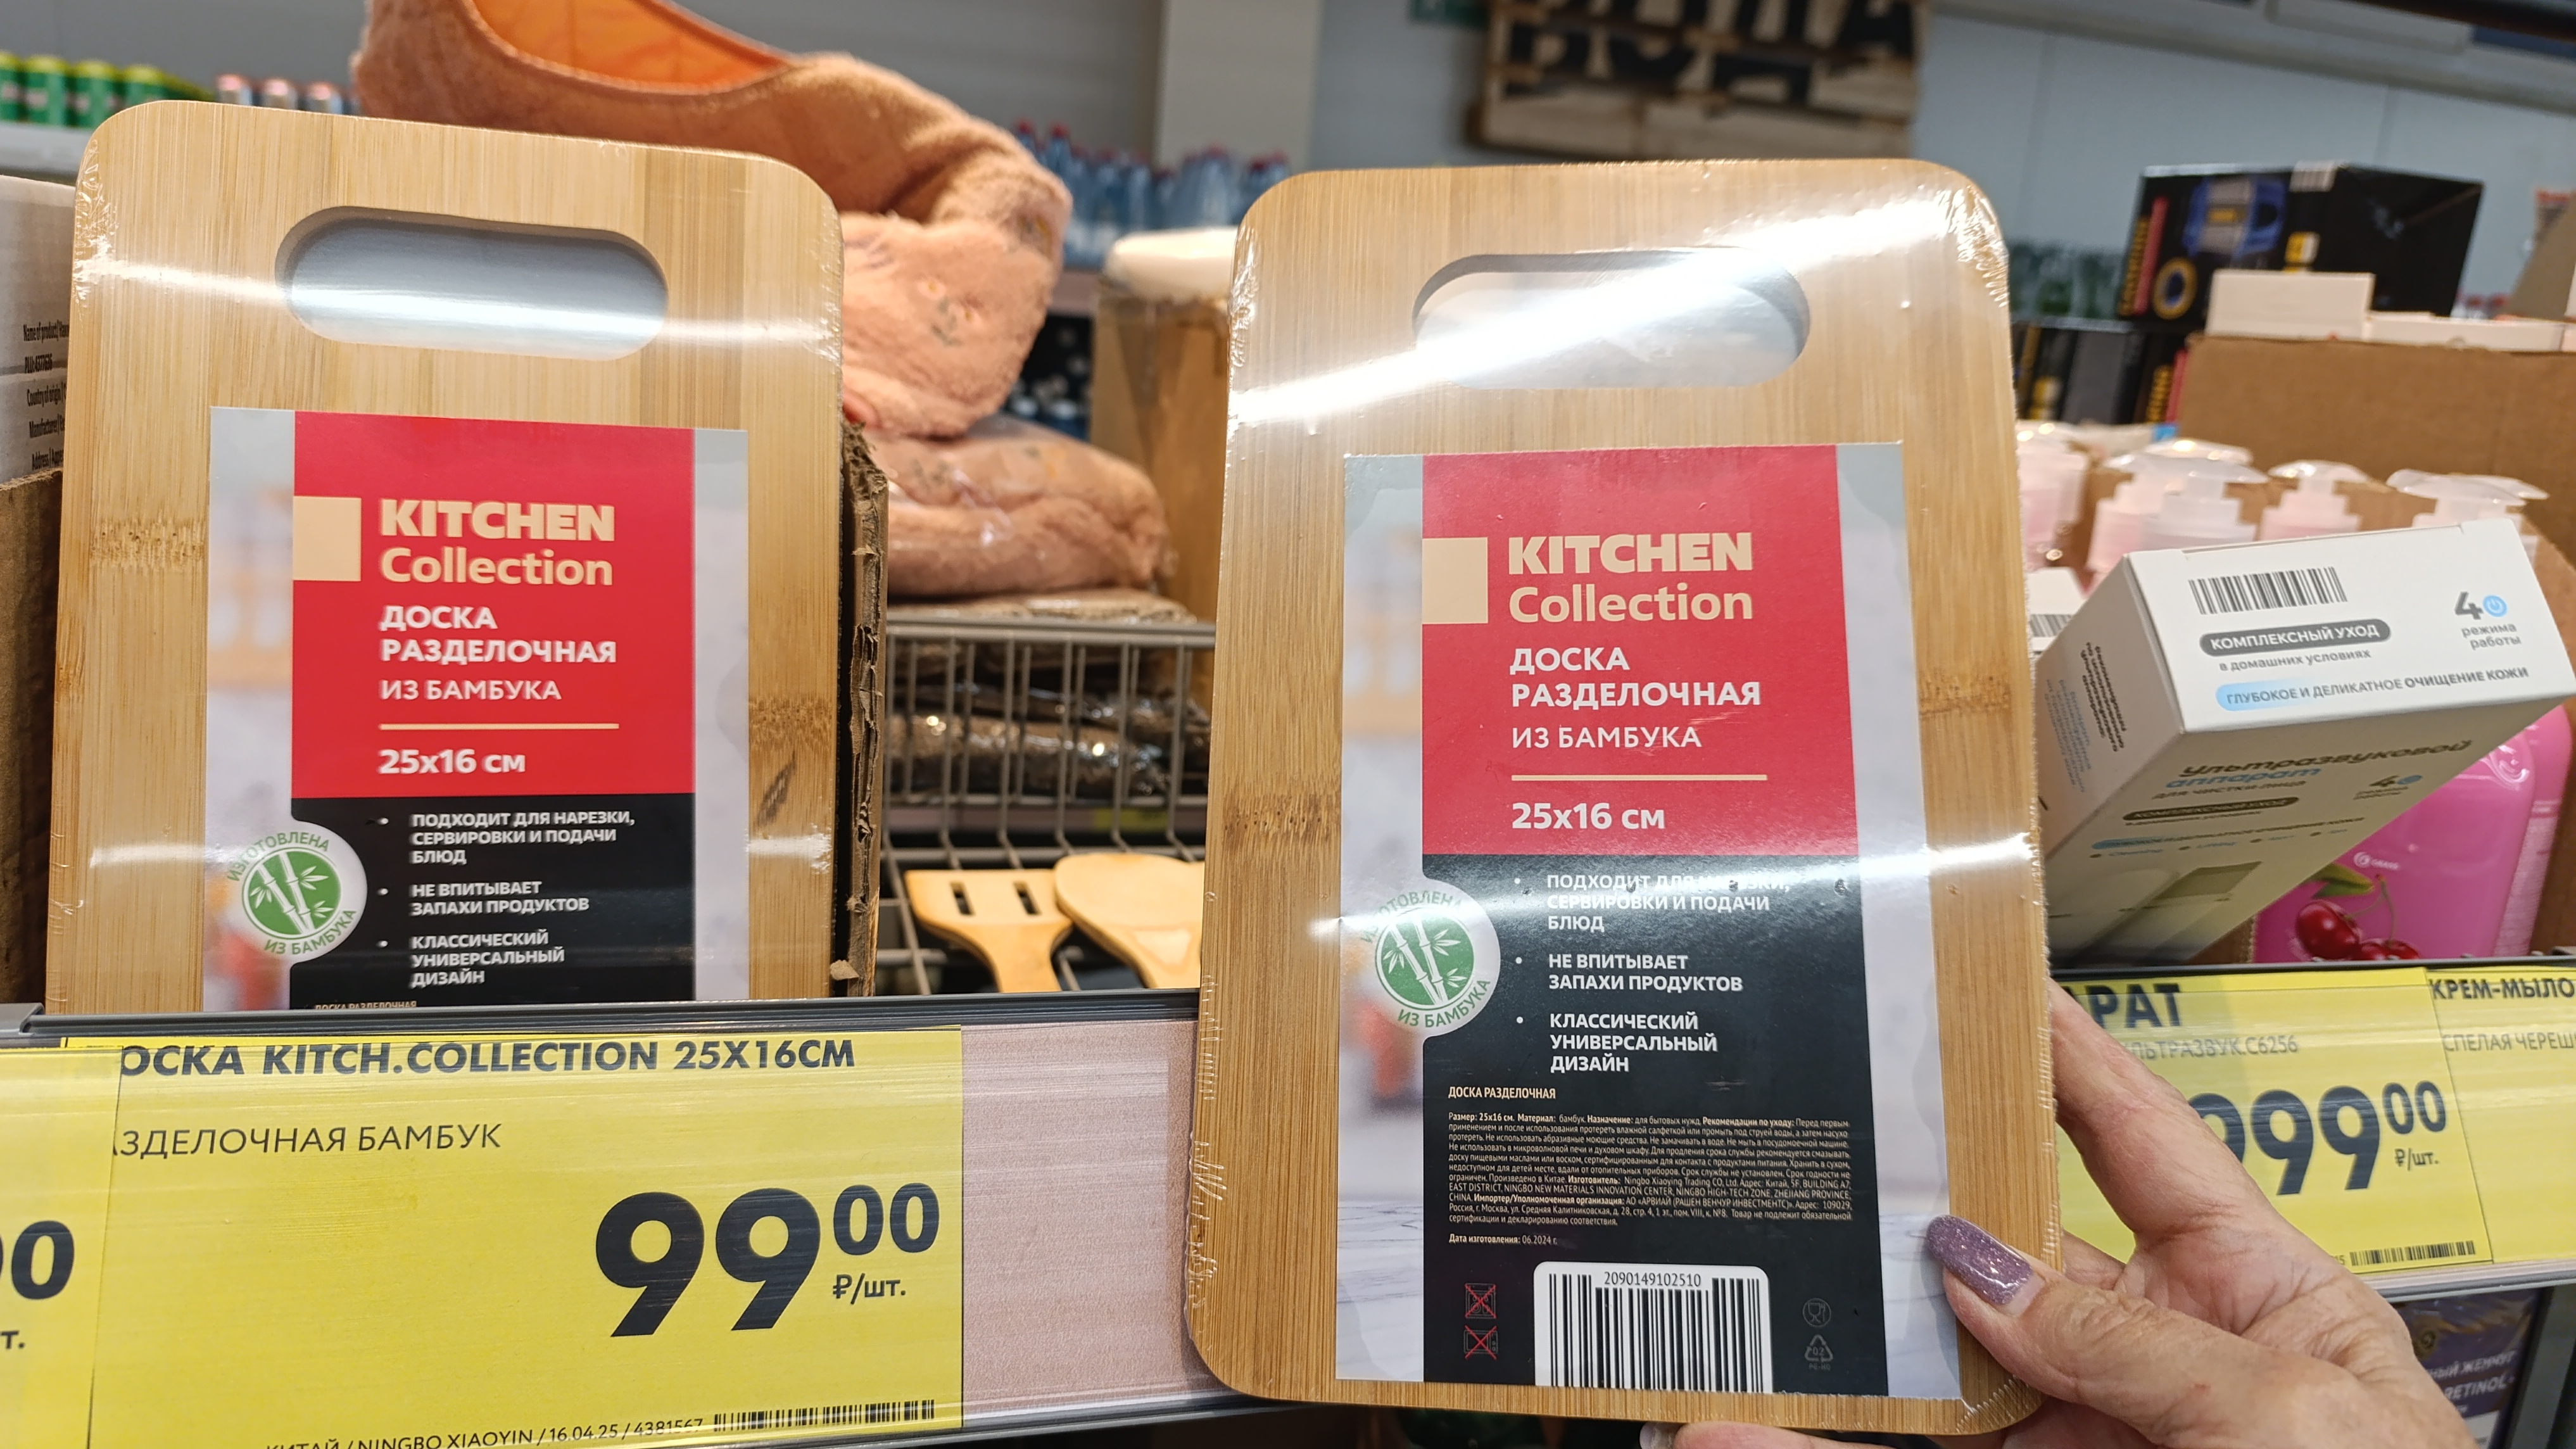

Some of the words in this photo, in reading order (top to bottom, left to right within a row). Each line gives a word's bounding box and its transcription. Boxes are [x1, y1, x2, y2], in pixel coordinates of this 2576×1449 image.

[380, 498, 616, 541] KITCHEN
[1508, 532, 1753, 574] KITCHEN
[380, 546, 614, 585] Collection
[1509, 581, 1753, 623] Collection
[2454, 591, 2484, 620] 4
[379, 605, 498, 631] ДОСКА
[2209, 626, 2335, 650] КОМПЛЕКСНЫЙ
[2334, 624, 2381, 640] УХОД
[2461, 623, 2517, 638] режима
[380, 638, 616, 665] РАЗДЕЛОЧНАЯ
[2470, 635, 2522, 650] работы
[1509, 647, 1630, 675] ДОСКА
[2219, 662, 2228, 671] в
[2230, 655, 2304, 673] домашних
[2305, 649, 2372, 666] условиях
[380, 679, 419, 700] ИЗ
[426, 680, 562, 700] БАМБУКА
[1511, 681, 1761, 710] РАЗДЕЛОЧНАЯ
[2226, 688, 2298, 705] ГЛУБОКОЕ
[2299, 687, 2311, 698] И
[2312, 678, 2403, 699] ДЕЛИКАТНОЕ
[2404, 670, 2485, 688] ОЧИЩЕНИЕ
[2485, 666, 2529, 681] КОЖИ
[1512, 727, 1550, 748] ИЗ
[1558, 726, 1702, 749] БАМБУКА
[378, 749, 477, 775] 25х16
[483, 754, 526, 773] см
[410, 813, 511, 830] ПОДХОДИТ
[514, 811, 551, 828] ДЛЯ
[553, 810, 635, 826] НАРЕЗКИ,
[1511, 802, 1612, 829] 25х16
[1621, 809, 1665, 829] см
[410, 830, 526, 845] СЕРВИРОВКИ
[529, 830, 543, 843] И
[545, 828, 617, 844] ПОДАЧИ
[227, 832, 330, 882] ИЗГОТОВЛЕНА
[410, 849, 467, 865] БЛЮД
[411, 883, 436, 898] НЕ
[439, 881, 542, 897] ВПИТЫВАЕТ
[1547, 875, 1651, 891] ПОДХОДИТ
[410, 900, 483, 916] ЗАПАХИ
[486, 897, 590, 915] ПРОДУКТОВ
[1547, 895, 1669, 910] СЕРВИРОВКИ
[1672, 895, 1687, 910] И
[1690, 896, 1770, 913] ПОДАЧИ
[264, 939, 286, 955] ИЗ
[291, 909, 357, 955] БАМБУКА
[1548, 916, 1605, 933] БЛЮД
[411, 929, 549, 950] КЛАССИЧЕСКИЙ
[410, 947, 565, 968] УНИВЕРСАЛЬНЫЙ
[1548, 953, 1573, 968] НЕ
[1576, 954, 1689, 970] ВПИТЫВАЕТ
[410, 968, 486, 989] ДИЗАЙН
[1549, 975, 1625, 990] ЗАПАХИ
[1628, 975, 1743, 994] ПРОДУКТОВ
[2428, 978, 2575, 999] КРЕМ-МЫЛО
[1397, 1008, 1420, 1027] ИЗ
[1424, 979, 1491, 1028] БАМБУКА
[1550, 1011, 1699, 1030] КЛАССИЧЕСКИЙ
[1550, 1032, 1719, 1053] УНИВЕРСАЛЬНЫЙ
[2441, 1033, 2512, 1051] СПЕЛАЯ
[2515, 1032, 2576, 1050] ЧЕРЕШ
[121, 1044, 244, 1076] ОСКА
[263, 1041, 658, 1075] KITCH.COLLECTION
[1550, 1054, 1629, 1075] ДИЗАЙН
[1448, 1086, 1482, 1099] ДОСКА
[1484, 1087, 1556, 1099] РАЗДЕЛОЧНАЯ
[2382, 1080, 2446, 1135] 00
[1448, 1112, 1478, 1123] Размер:
[1479, 1113, 1502, 1122] 25х16
[1517, 1113, 1556, 1123] Материал:
[1558, 1114, 1585, 1124] бамбук.
[1587, 1115, 1634, 1124] Назначение:
[1634, 1117, 1648, 1125] для
[1649, 1115, 1679, 1125] бытовых
[1681, 1117, 1702, 1127] нужд.
[1702, 1116, 1757, 1127] Рекомендации
[1769, 1119, 1795, 1128] уходу:
[1795, 1118, 1819, 1128] Перед
[1820, 1119, 1848, 1129] первым
[113, 1126, 345, 1160] ЗДЕЛОЧНАЯ
[358, 1123, 503, 1151] БАМБУК
[2394, 1148, 2440, 1171] ₽/шт.
[1448, 1182, 1467, 1192] EAST
[1468, 1183, 1503, 1193] DISTRICT,
[1504, 1184, 1533, 1193] NINGBO
[1534, 1185, 1551, 1193] NEW
[1553, 1185, 1594, 1194] MATERIALS
[1596, 1186, 1642, 1195] INNOVATION
[1644, 1186, 1674, 1196] CENTER,
[1676, 1187, 1705, 1196] NINGBO
[1707, 1187, 1748, 1198] HIGH-TECH
[1774, 1189, 1810, 1199] ZHEJIANG
[1811, 1189, 1852, 1200] PROVINCE,
[1474, 1194, 1575, 1204] Импортер/Уполномоченная
[1576, 1196, 1625, 1205] организация:
[1626, 1196, 1636, 1205] АО
[1638, 1196, 1671, 1206] «АРВИАЙ
[1673, 1197, 1701, 1207] (РАШЕН
[1702, 1198, 1731, 1207] ВЕНЧУР
[1795, 1200, 1819, 1210] Адрес:
[1448, 1233, 1467, 1244] Дата
[1468, 1236, 1520, 1244] изготовления:
[1522, 1235, 1551, 1245] 06.2024
[0, 1220, 75, 1300] 0
[595, 1187, 821, 1338] 99
[833, 1182, 940, 1256] 00
[831, 1273, 906, 1305] ₽/шт.
[1603, 1271, 1703, 1288] 2090149102510
[447, 1429, 533, 1449] XIAOYIN
[549, 1423, 619, 1441] 16.04.25
